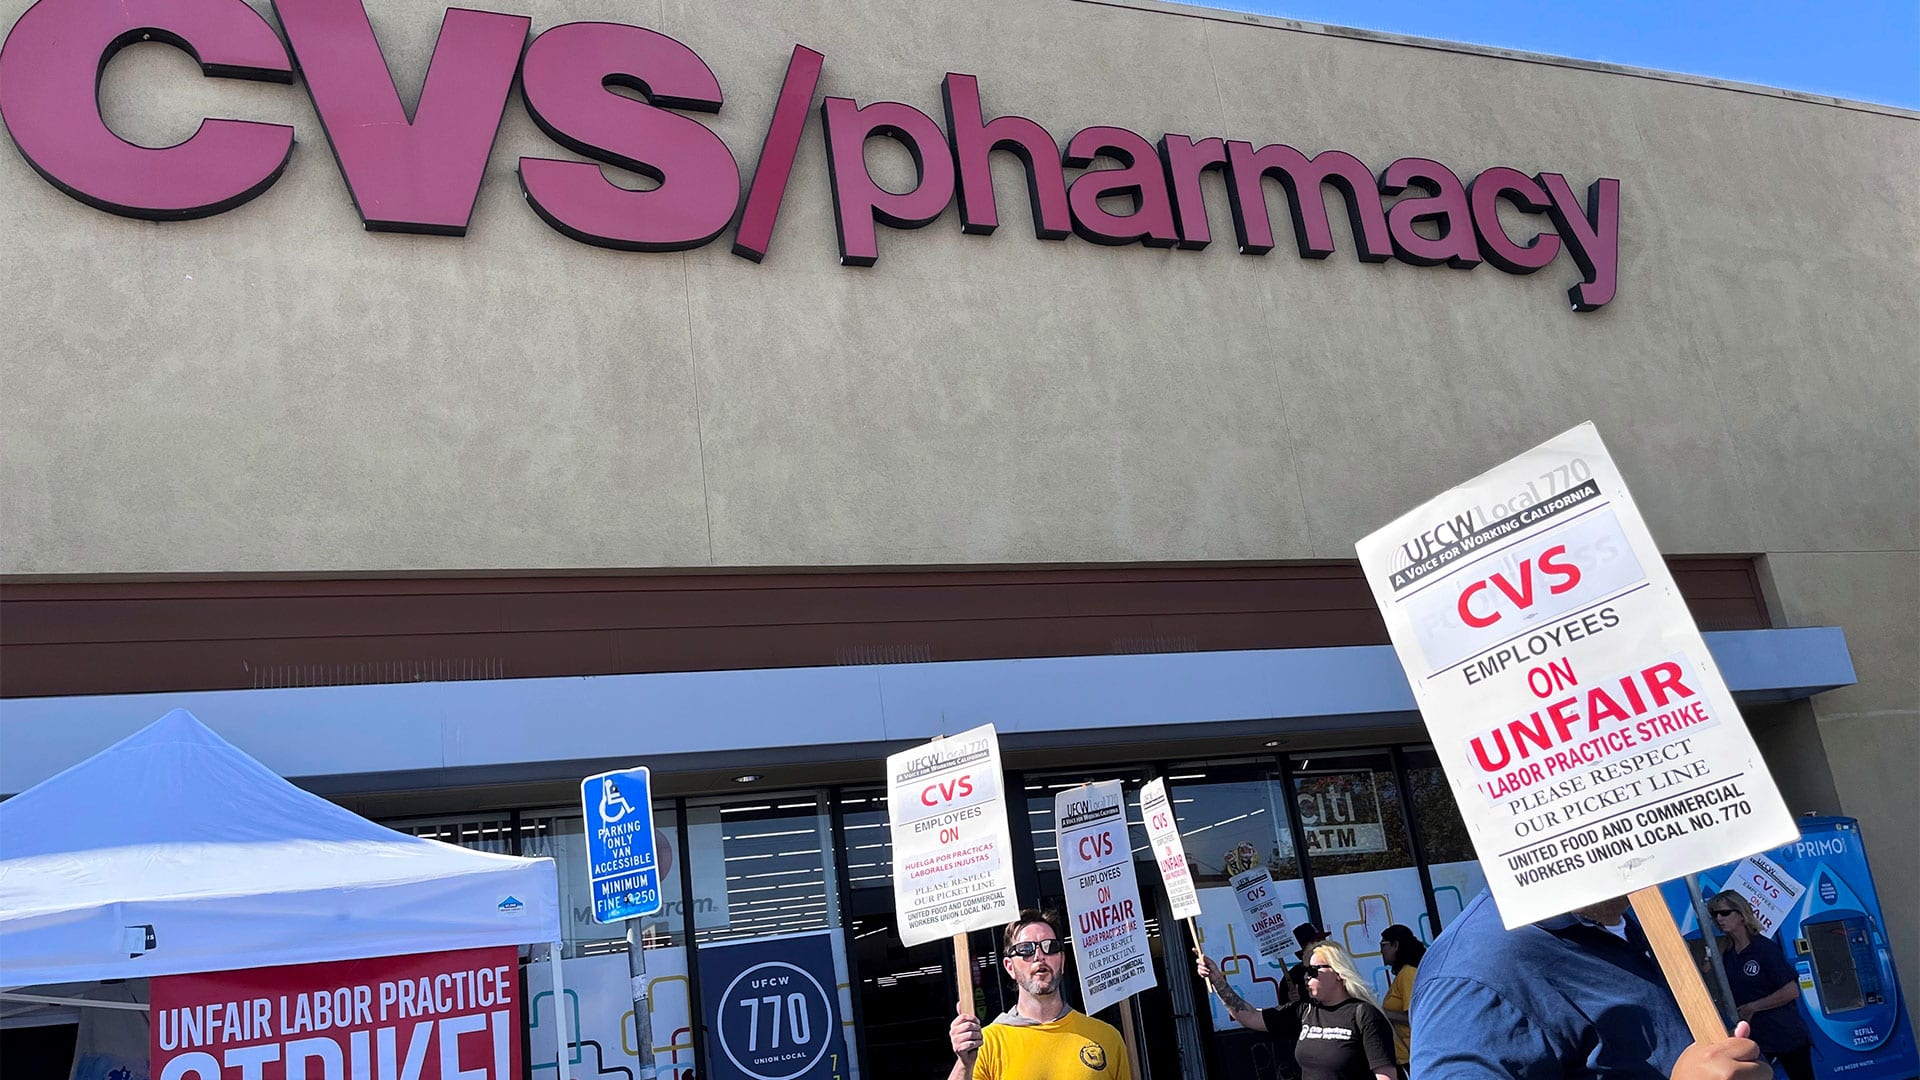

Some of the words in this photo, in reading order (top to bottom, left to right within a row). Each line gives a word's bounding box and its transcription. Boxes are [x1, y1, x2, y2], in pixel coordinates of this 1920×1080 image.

[1403, 510, 1476, 563] UFCW
[1474, 482, 1541, 527] Local
[1540, 457, 1591, 496] 770
[1394, 575, 1407, 586] A
[1406, 557, 1440, 580] VOICE
[1438, 546, 1461, 565] FOR
[1458, 518, 1521, 552] WORKING
[1520, 485, 1596, 524] CALIFORNIA
[1457, 544, 1582, 629] CVS
[1462, 607, 1620, 686] EMPLOYEES
[1527, 656, 1579, 699] ON
[1469, 661, 1696, 773] UNFAIR
[906, 752, 939, 773] UFCW
[968, 738, 989, 753] 770
[1487, 762, 1545, 800] LABOR
[1543, 729, 1637, 776] PRACTICE
[1636, 700, 1710, 743] STRIKE
[1508, 776, 1586, 816] PLEASE
[1585, 738, 1692, 786] RESPECT
[921, 775, 973, 807] CVS
[1514, 812, 1562, 838] OUR
[1561, 780, 1644, 820] PICKET
[1644, 759, 1711, 792] LINE
[1297, 784, 1356, 825] citi
[597, 820, 641, 840] PARKING
[915, 807, 982, 833] EMPLOYEES
[1152, 812, 1168, 830] CVS
[1507, 842, 1559, 871] UNITED
[1560, 829, 1599, 852] FOOD
[1602, 817, 1634, 840] AND
[1636, 782, 1745, 827] COMMERCIAL
[607, 834, 633, 850] ONLY
[940, 826, 959, 844] ON
[1078, 831, 1113, 861] CVS
[1305, 828, 1357, 849] ATM
[1514, 854, 1586, 887] WORKERS
[1583, 838, 1634, 866] UNION
[1634, 820, 1688, 848] LOCAL
[1689, 810, 1720, 832] NO.
[1718, 799, 1752, 823] 770
[612, 846, 631, 859] VAN
[904, 859, 935, 870] HUELGA
[935, 853, 952, 863] POR
[952, 842, 994, 859] PRACTICAS
[1796, 838, 1844, 859] PRIMO
[594, 852, 652, 875] ACCESSIBLE
[910, 863, 953, 879] LABORALES
[954, 853, 990, 868] INJUSTAS
[1160, 854, 1185, 873] UNFAIR
[601, 874, 649, 896] MINIMUM
[915, 882, 948, 896] PLEASE
[951, 870, 992, 887] RESPECT
[1080, 866, 1121, 889] EMPLOYEES
[1753, 874, 1780, 899] CVS
[597, 896, 621, 913] FINE
[914, 896, 935, 906] OUR
[936, 885, 971, 903] PICKET
[972, 879, 996, 892] LINE
[1097, 886, 1111, 904] ON
[1247, 886, 1266, 901] CVS
[907, 908, 930, 921] UNITED
[931, 904, 948, 916] FOOD
[948, 900, 962, 911] AND
[963, 891, 1005, 909] COMMERCIAL
[908, 917, 939, 929] WORKERS
[940, 910, 959, 922] UNION
[960, 905, 981, 916] LOCAL
[993, 899, 1006, 909] 770
[1079, 899, 1135, 934] UNFAIR
[1251, 913, 1284, 933] UNFAIR
[1082, 934, 1100, 948] LABOR
[751, 976, 790, 989] UFCW
[159, 998, 274, 1052] UNFAIR
[280, 984, 373, 1037] LABOR
[379, 965, 512, 1024] PRACTICE
[739, 992, 811, 1052] 770
[1854, 1026, 1874, 1037] REFILL
[1853, 1035, 1879, 1046] STATION
[753, 1056, 779, 1065] UNION
[781, 1052, 807, 1061] LOCAL
